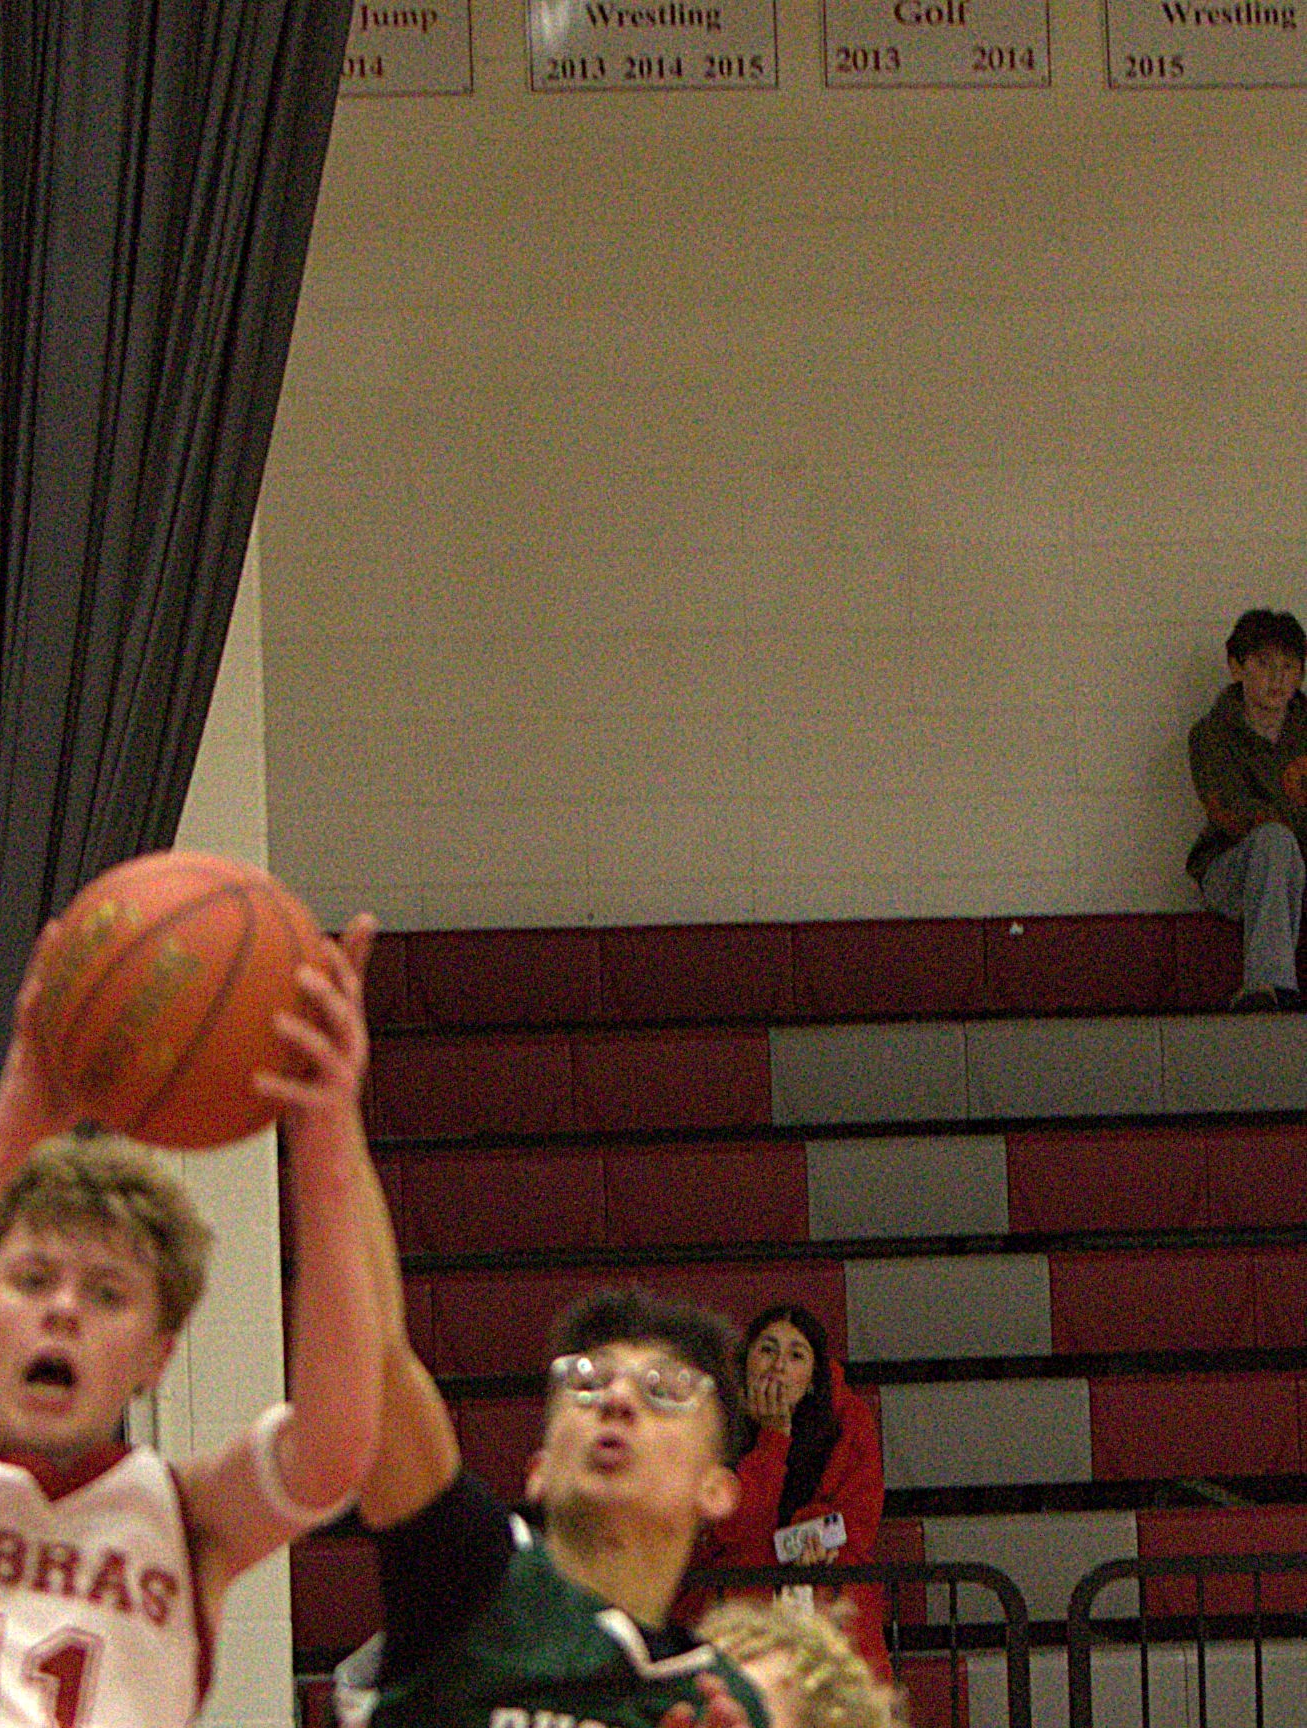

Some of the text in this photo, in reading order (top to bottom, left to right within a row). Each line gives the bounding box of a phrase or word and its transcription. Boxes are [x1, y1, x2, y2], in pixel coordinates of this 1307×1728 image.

[359, 3, 438, 33] Jump
[586, 3, 721, 31] Wrestling
[894, 0, 968, 27] Golf
[1162, 1, 1298, 29] Wrestling
[342, 56, 384, 78] 014
[547, 55, 764, 81] 2013 2014 2015
[836, 46, 1035, 73] 2013 2014
[1124, 54, 1185, 79] 2015
